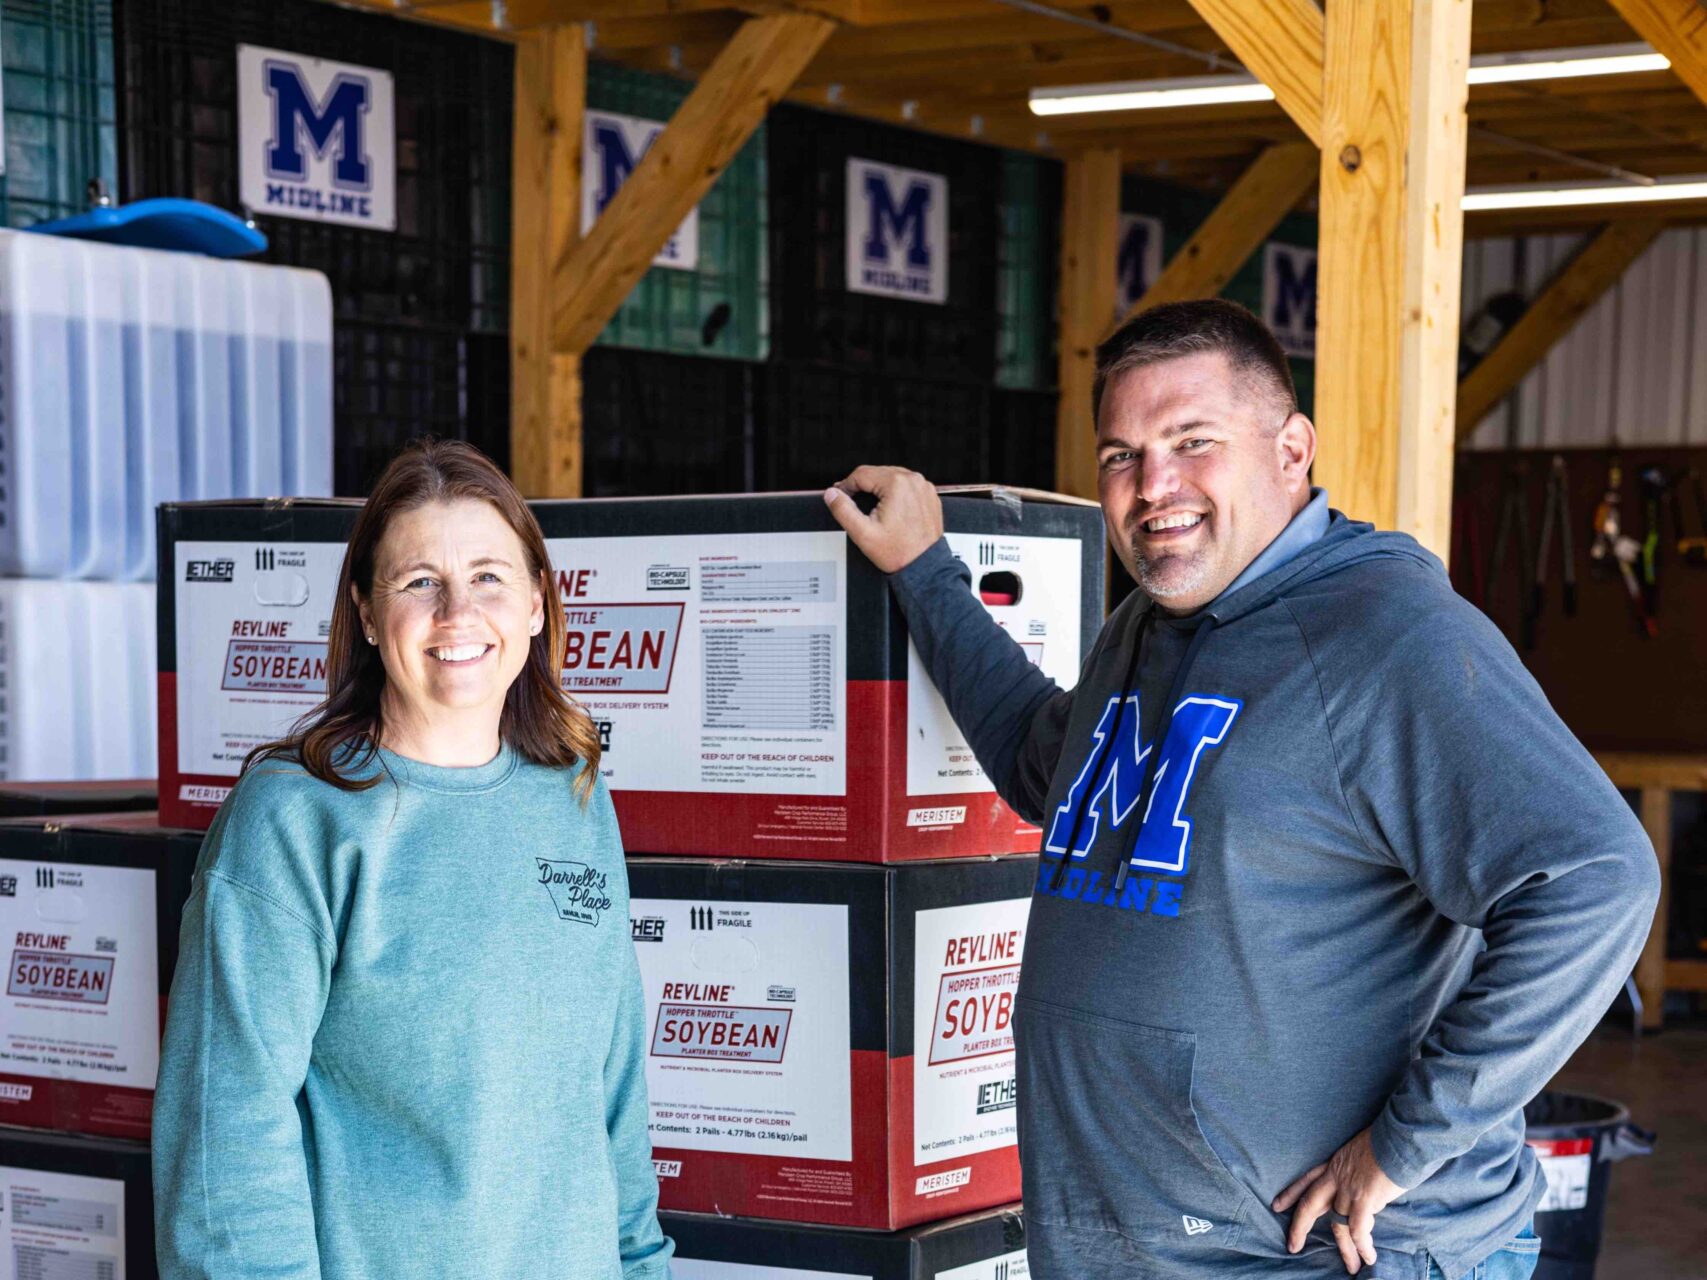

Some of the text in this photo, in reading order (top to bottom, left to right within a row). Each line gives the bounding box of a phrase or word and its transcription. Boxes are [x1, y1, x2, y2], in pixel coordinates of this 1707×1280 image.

[264, 60, 371, 191] M
[266, 184, 371, 217] MIDLINE
[864, 172, 932, 269] M
[232, 619, 288, 638] REVLINE
[562, 630, 666, 670] BEAN
[231, 655, 326, 681] SOYBEAN
[574, 677, 623, 687] TREATMENT
[593, 702, 607, 710] BOX
[608, 702, 641, 710] DELIVERY
[643, 703, 669, 711] SYSTEM
[937, 769, 947, 777] Net
[188, 788, 230, 799] MERIST
[1045, 692, 1243, 876] M
[915, 809, 963, 822] MERISTEM
[538, 863, 607, 889] Darrell's
[568, 886, 612, 910] Place
[717, 919, 752, 928] FRAGILE
[16, 930, 68, 950] REVLINE
[944, 931, 1017, 967] REVLINE
[15, 963, 105, 992] SOYBEAN
[947, 977, 980, 993] HOPPER
[662, 983, 731, 1002] REVLINE
[666, 1008, 735, 1019] HOPPER THROTTLE
[942, 991, 1012, 1039] SOYB
[662, 1019, 780, 1048] SOYBEAN
[720, 1049, 752, 1057] TREATMENT
[963, 1039, 989, 1053] PLANTER
[990, 1038, 1001, 1048] BOX
[656, 1124, 720, 1136] Contents: 2 Pails
[718, 1115, 742, 1123] REACH
[755, 1117, 791, 1126] CHILDREN
[921, 1143, 931, 1151] Net
[931, 1139, 955, 1149] Contents:
[963, 1134, 975, 1142] Pails
[922, 1171, 969, 1190] MERISTEM
